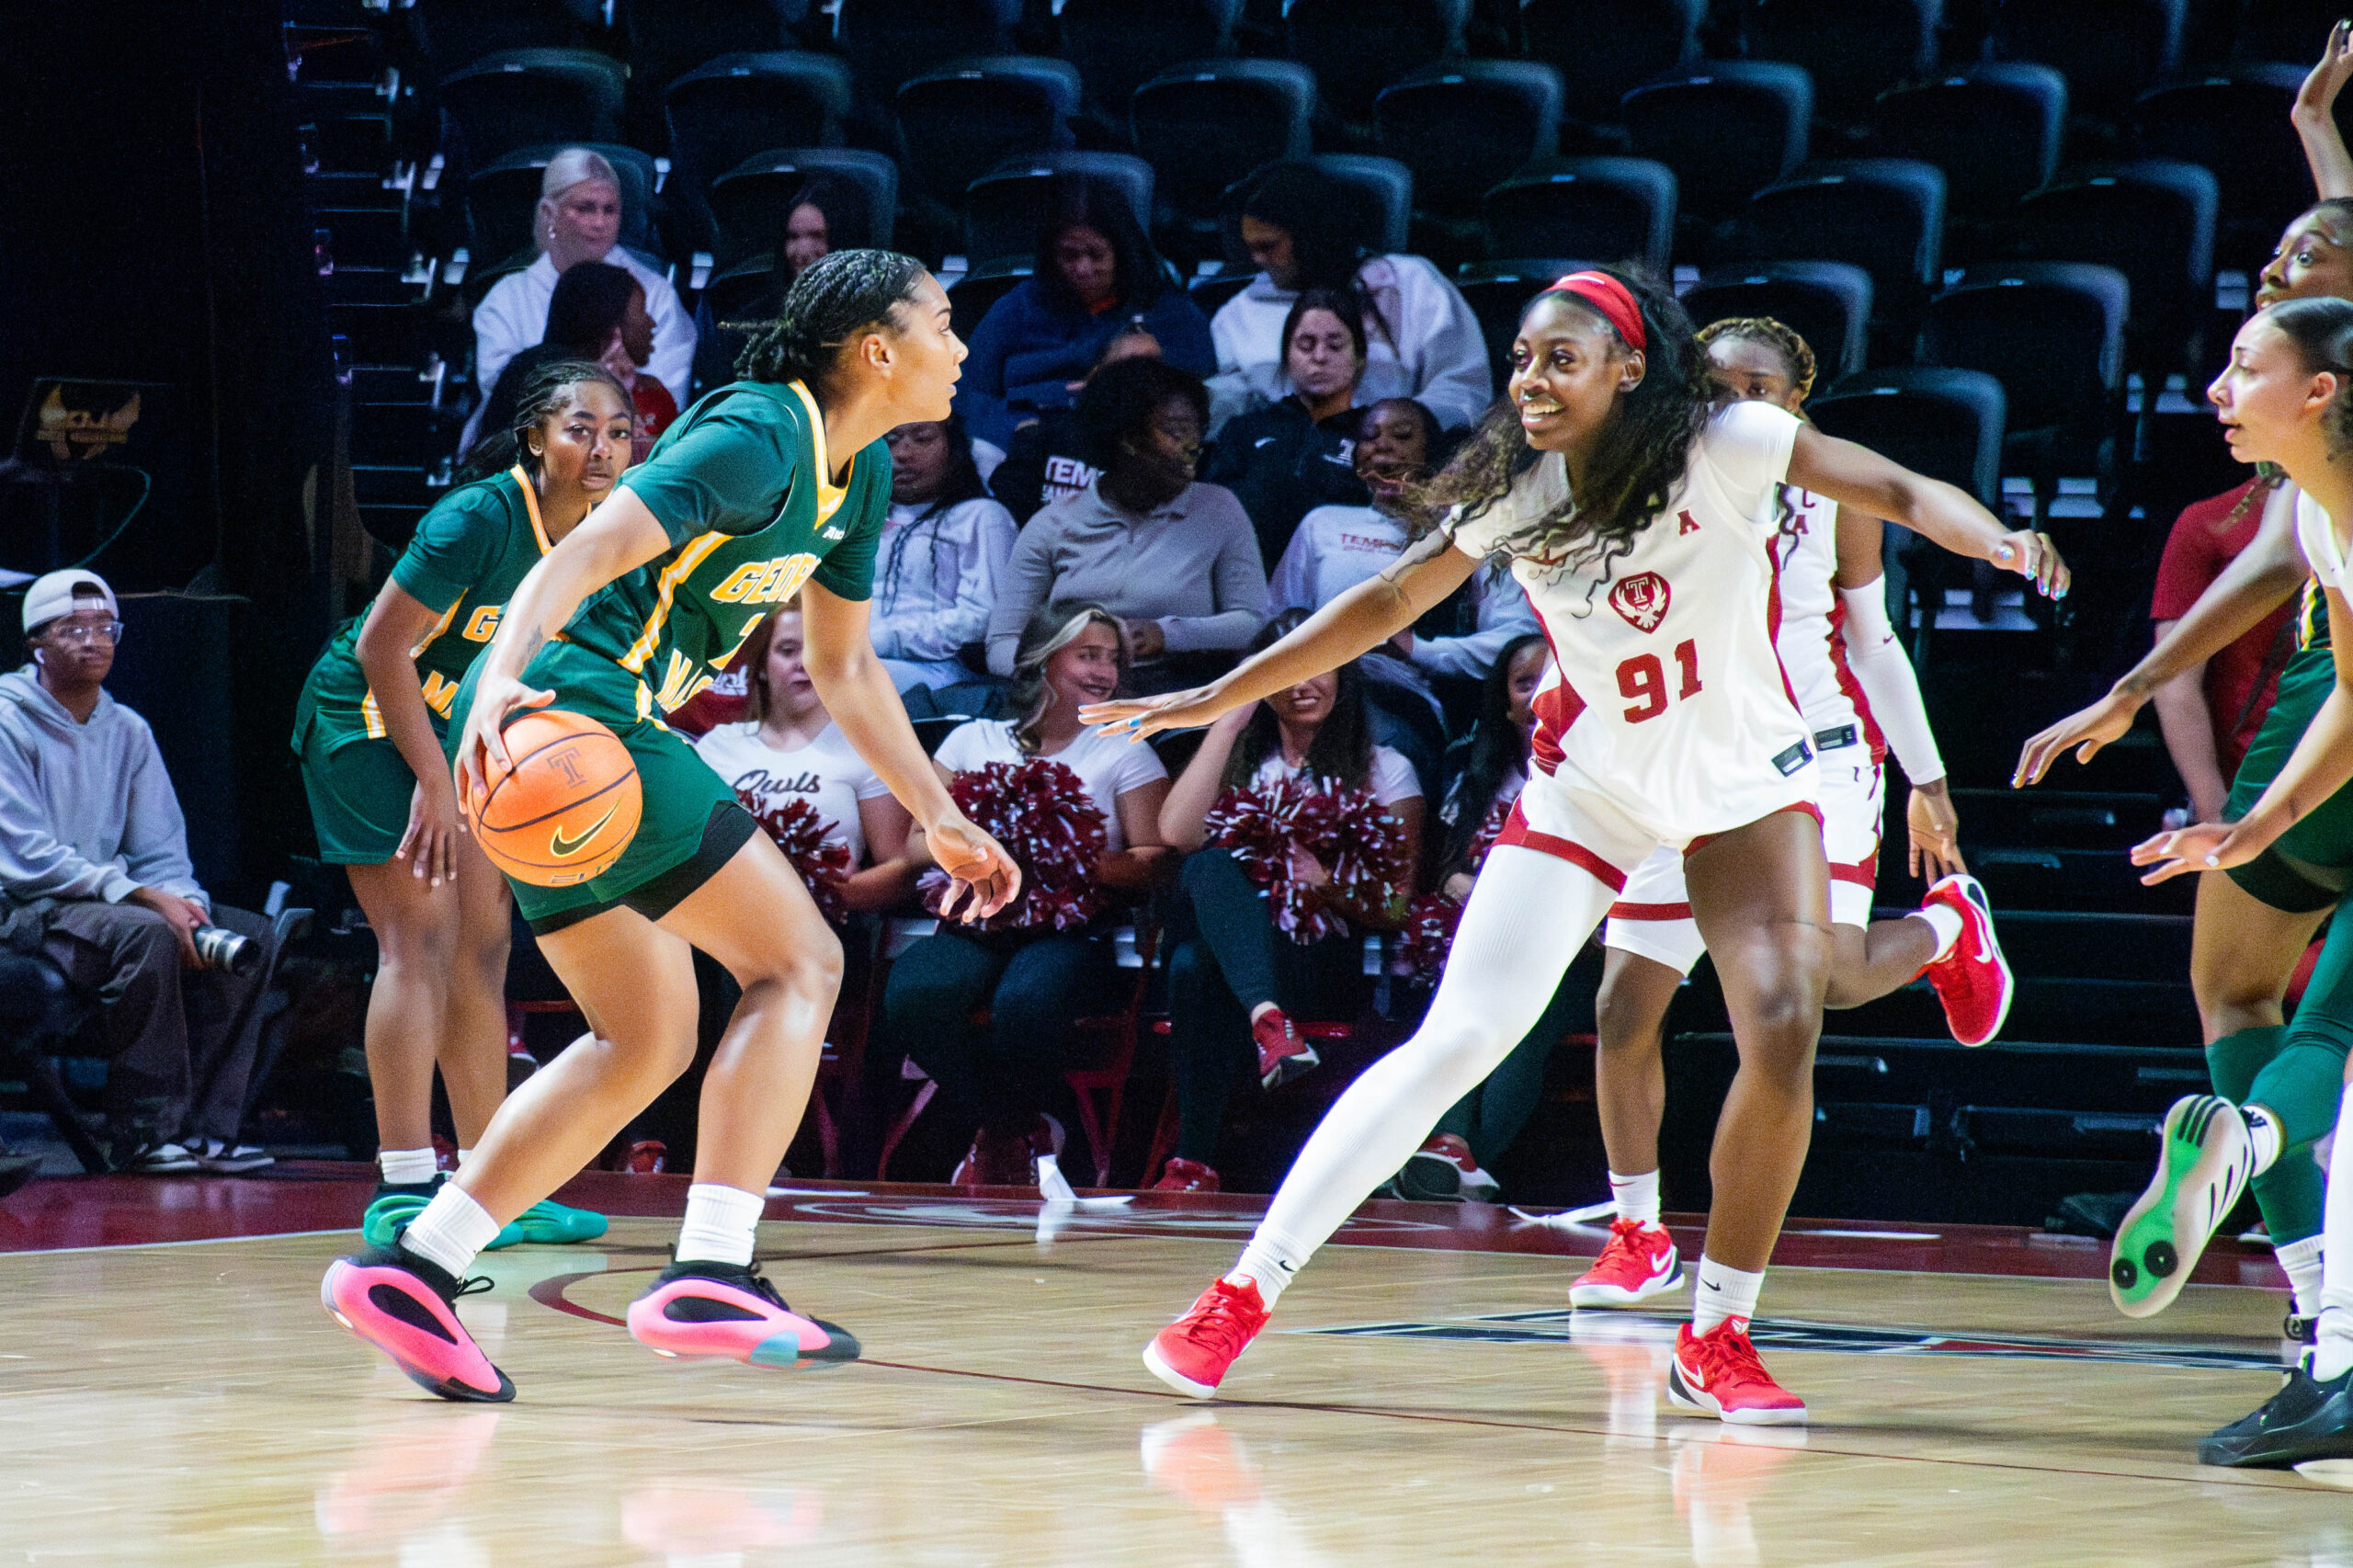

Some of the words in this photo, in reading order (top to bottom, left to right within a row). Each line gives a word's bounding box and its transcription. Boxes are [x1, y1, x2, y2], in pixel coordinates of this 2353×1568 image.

[1677, 509, 1701, 536] A
[1792, 514, 1809, 535] A
[1625, 577, 1649, 603] T
[1615, 638, 1702, 724] 91
[546, 746, 588, 788] T
[733, 769, 821, 794] Owls
